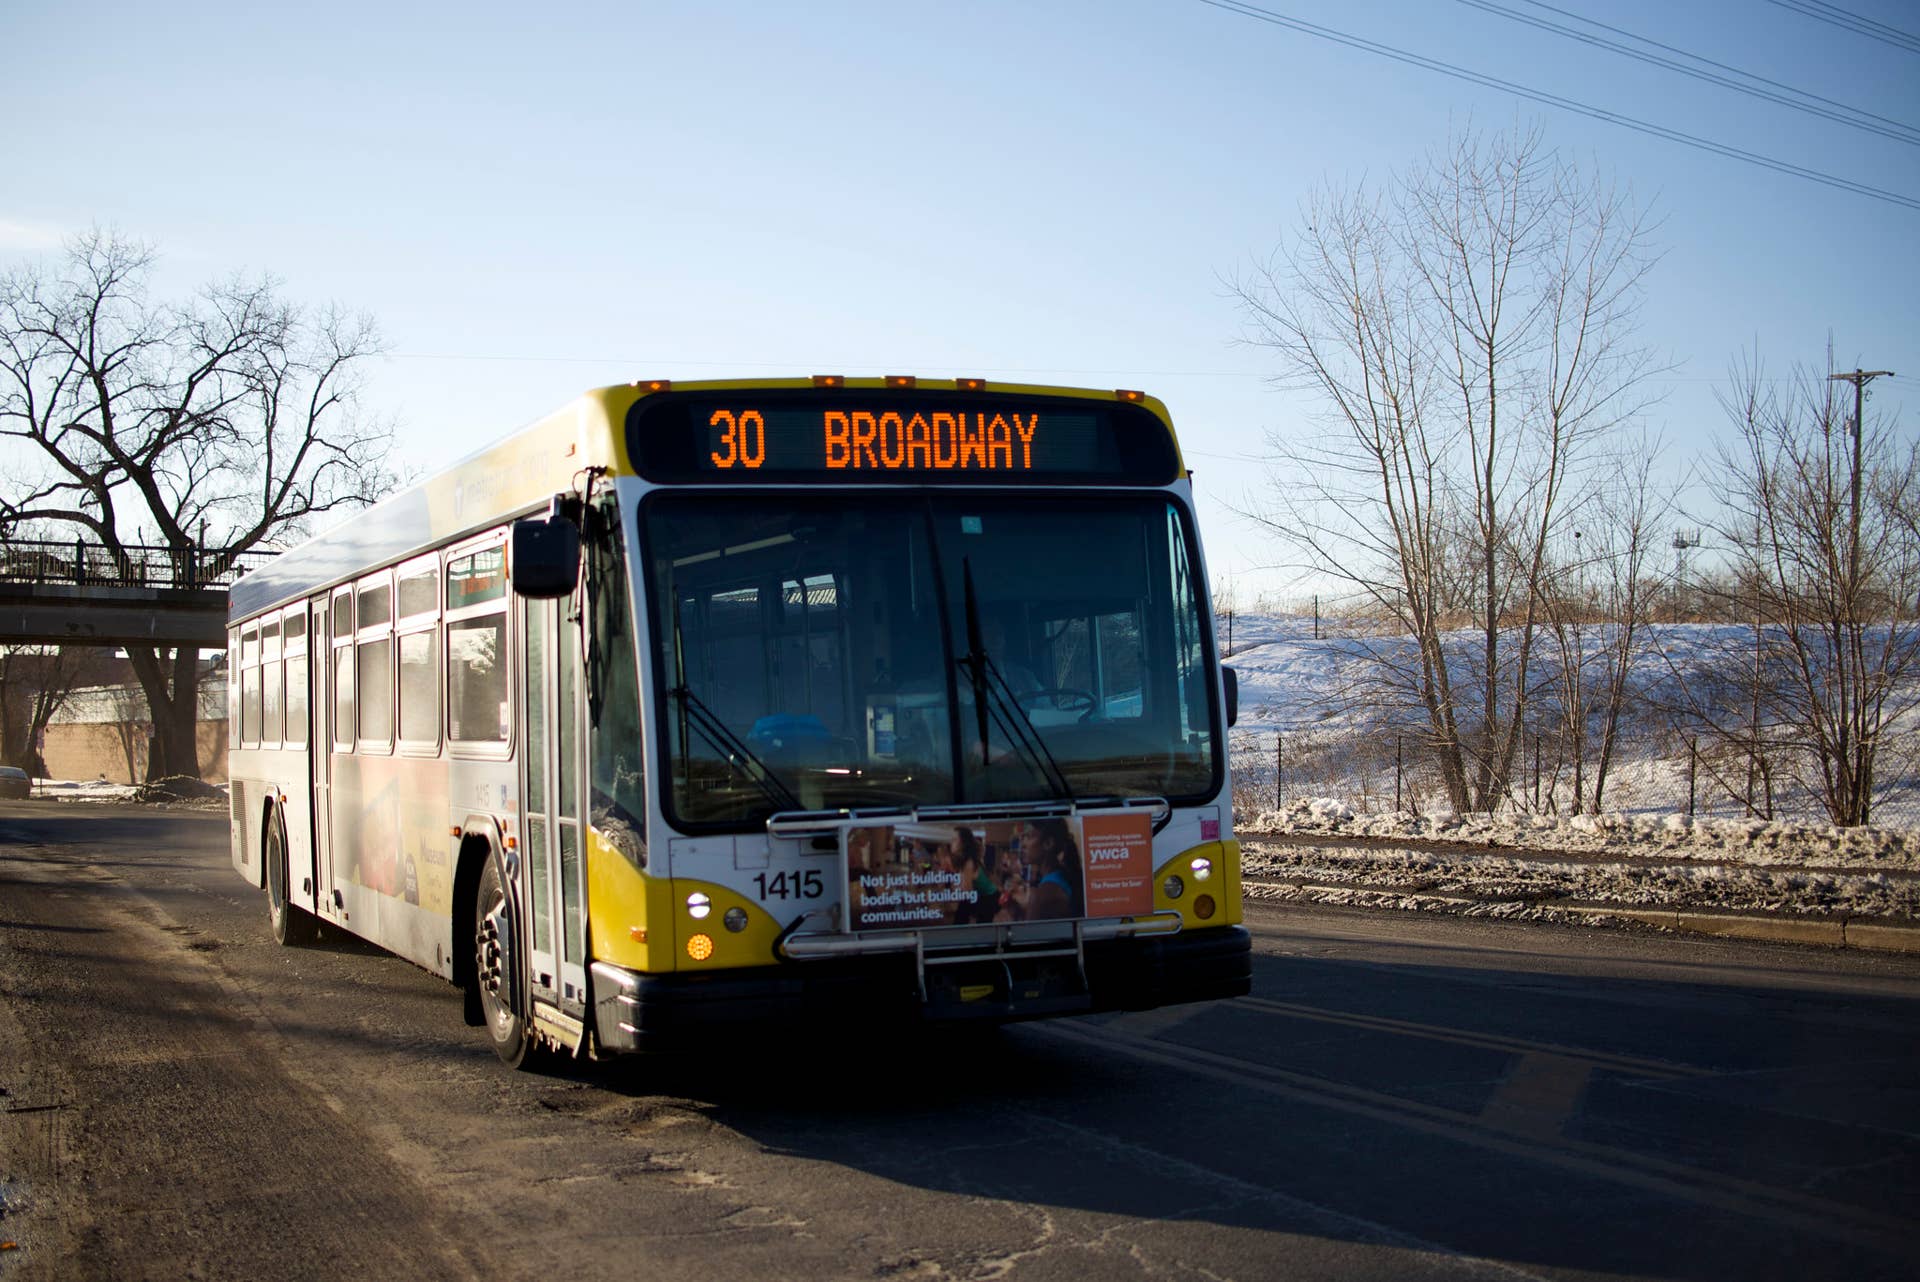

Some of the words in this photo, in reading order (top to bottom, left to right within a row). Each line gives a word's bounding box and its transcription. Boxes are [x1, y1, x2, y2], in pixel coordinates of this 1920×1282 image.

[710, 410, 765, 468] 30
[824, 411, 1038, 468] BROADWAY
[1090, 847, 1129, 864] ywca
[753, 869, 824, 901] 1415
[860, 874, 885, 888] Not
[885, 873, 909, 889] just
[911, 870, 962, 888] building
[860, 891, 902, 906] bodies
[904, 890, 927, 905] but
[928, 889, 979, 905] building
[861, 907, 945, 923] communities.
